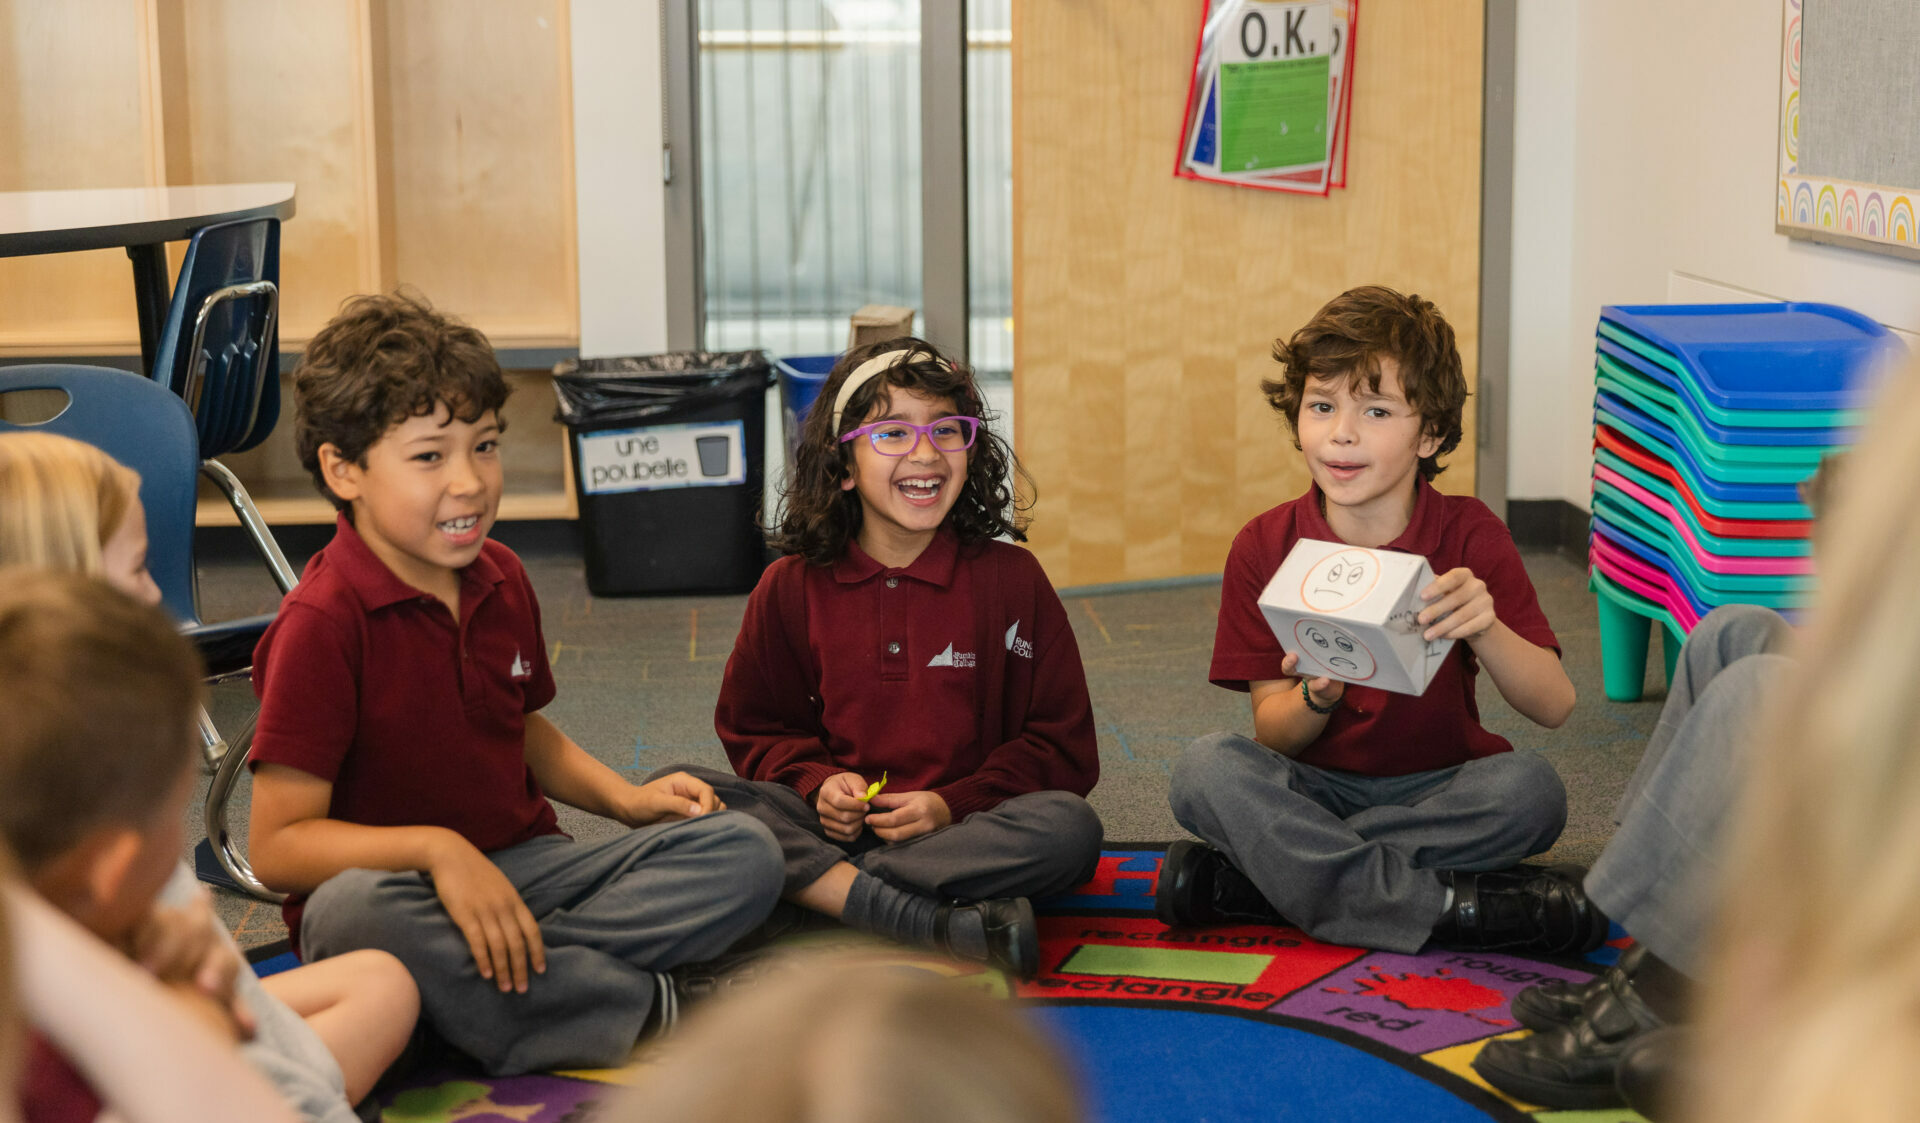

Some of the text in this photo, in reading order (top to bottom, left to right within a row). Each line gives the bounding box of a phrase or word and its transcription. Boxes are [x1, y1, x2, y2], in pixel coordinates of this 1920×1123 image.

[1240, 8, 1315, 58] O.K.
[616, 436, 660, 457] une
[592, 457, 689, 487] poubelle
[1079, 929, 1301, 948] rectangle
[1324, 1006, 1424, 1032] red
